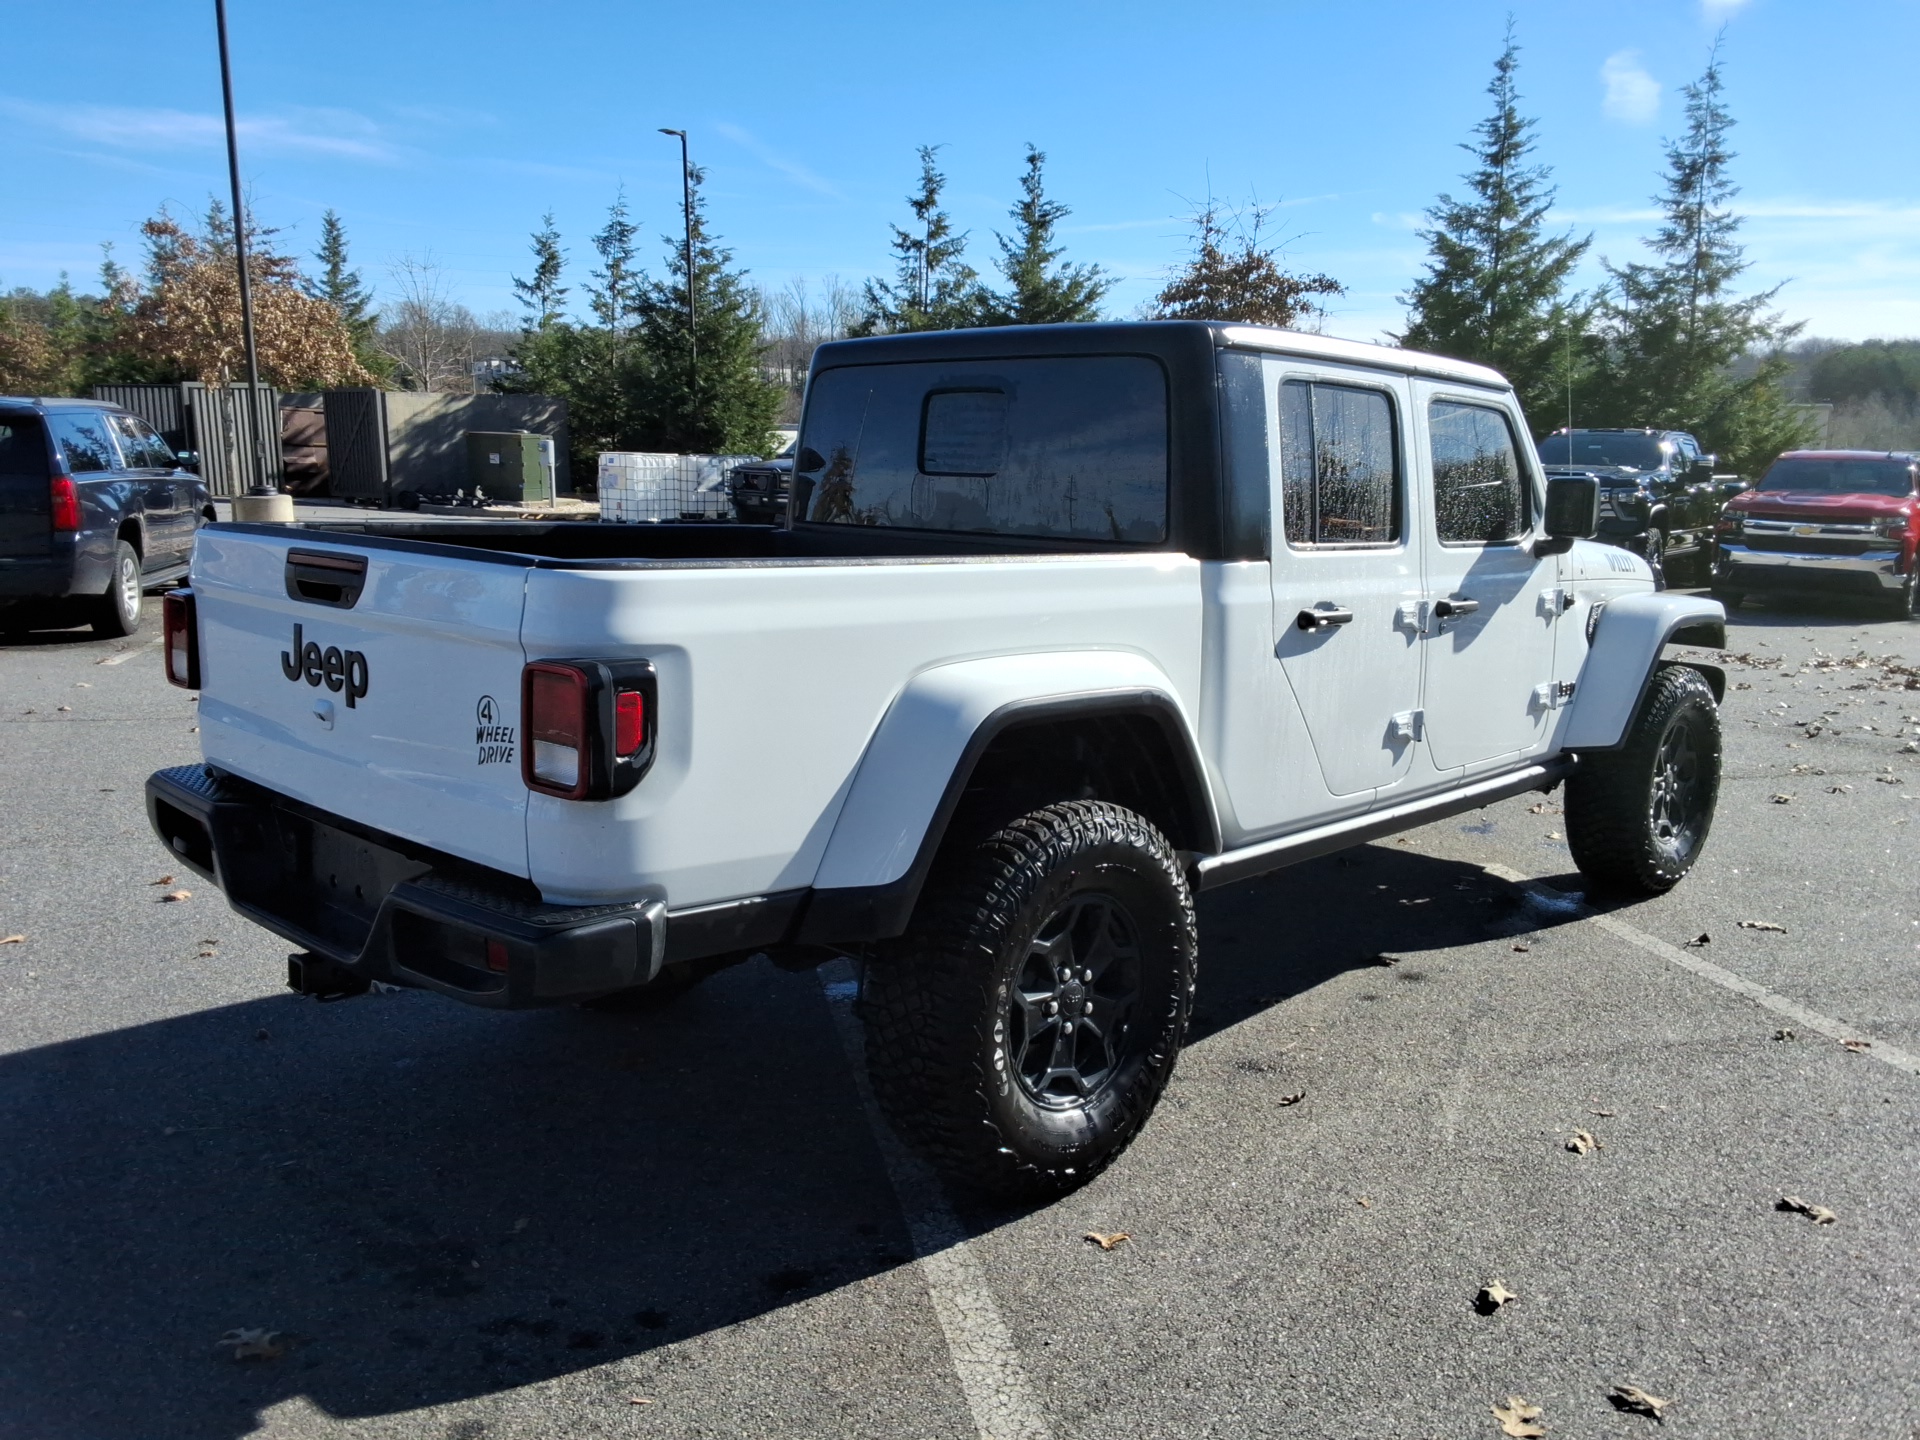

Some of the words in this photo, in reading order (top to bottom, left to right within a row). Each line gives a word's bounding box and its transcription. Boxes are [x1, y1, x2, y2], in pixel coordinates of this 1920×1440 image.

[281, 623, 369, 709] Jeep
[481, 700, 492, 724] 4
[476, 726, 514, 744] WHEEL
[478, 746, 514, 765] DRIVE
